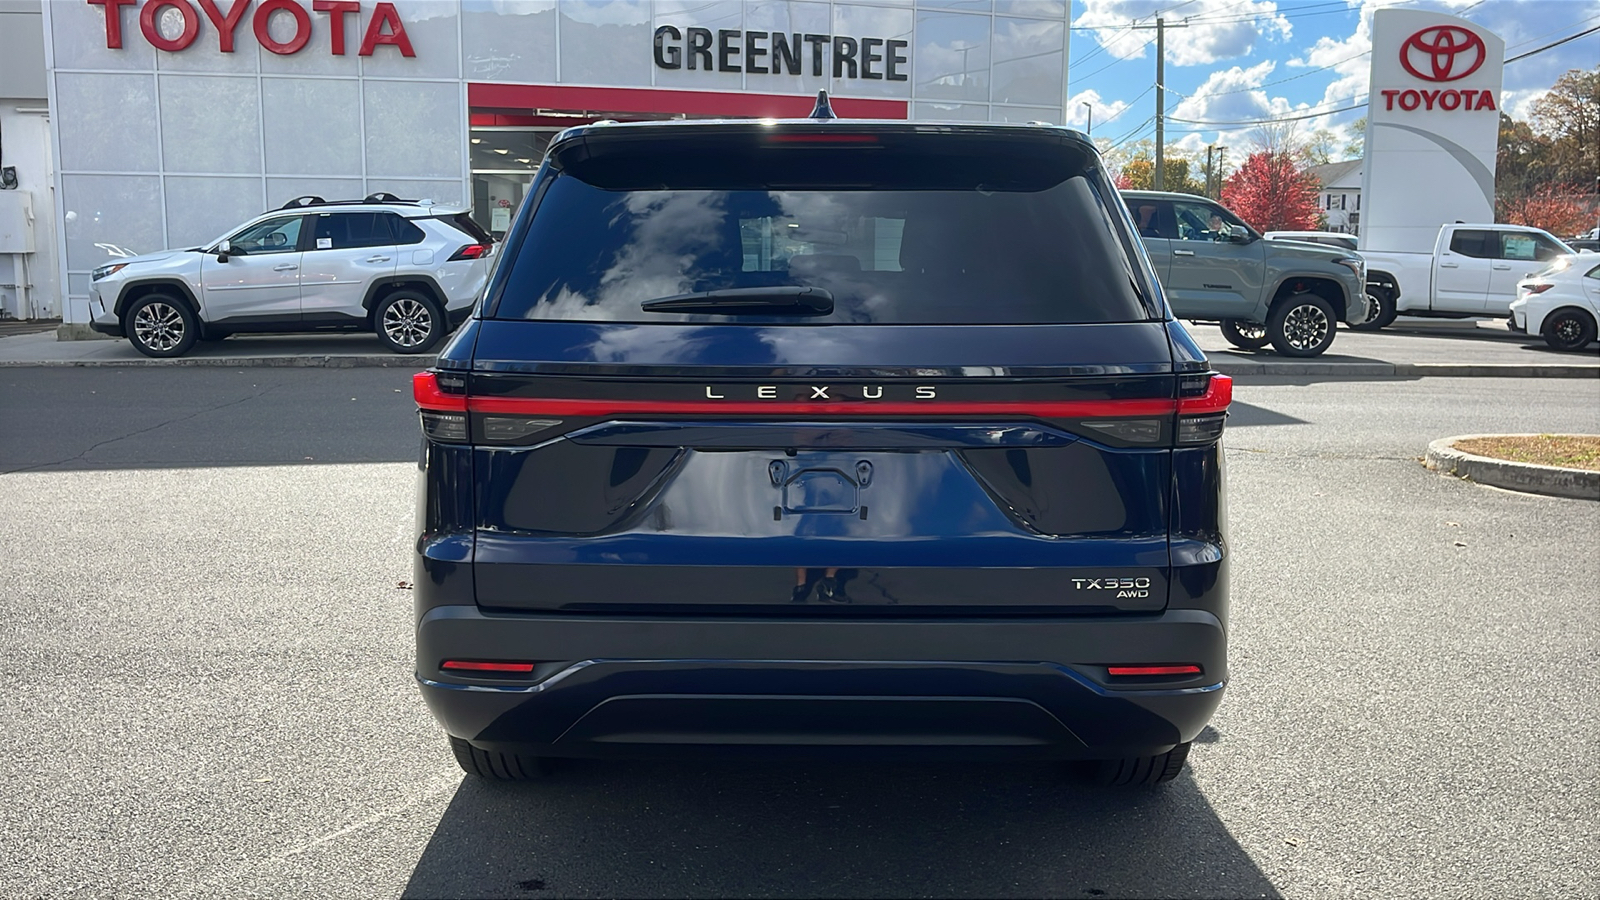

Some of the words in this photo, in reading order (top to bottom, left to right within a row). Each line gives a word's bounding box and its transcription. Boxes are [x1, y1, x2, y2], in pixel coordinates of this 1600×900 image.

[87, 0, 417, 58] TOYOTA
[653, 25, 909, 82] GREENTREE
[1381, 89, 1497, 112] TOYOTA
[705, 385, 937, 400] LEXUS
[1116, 590, 1149, 599] AWD
